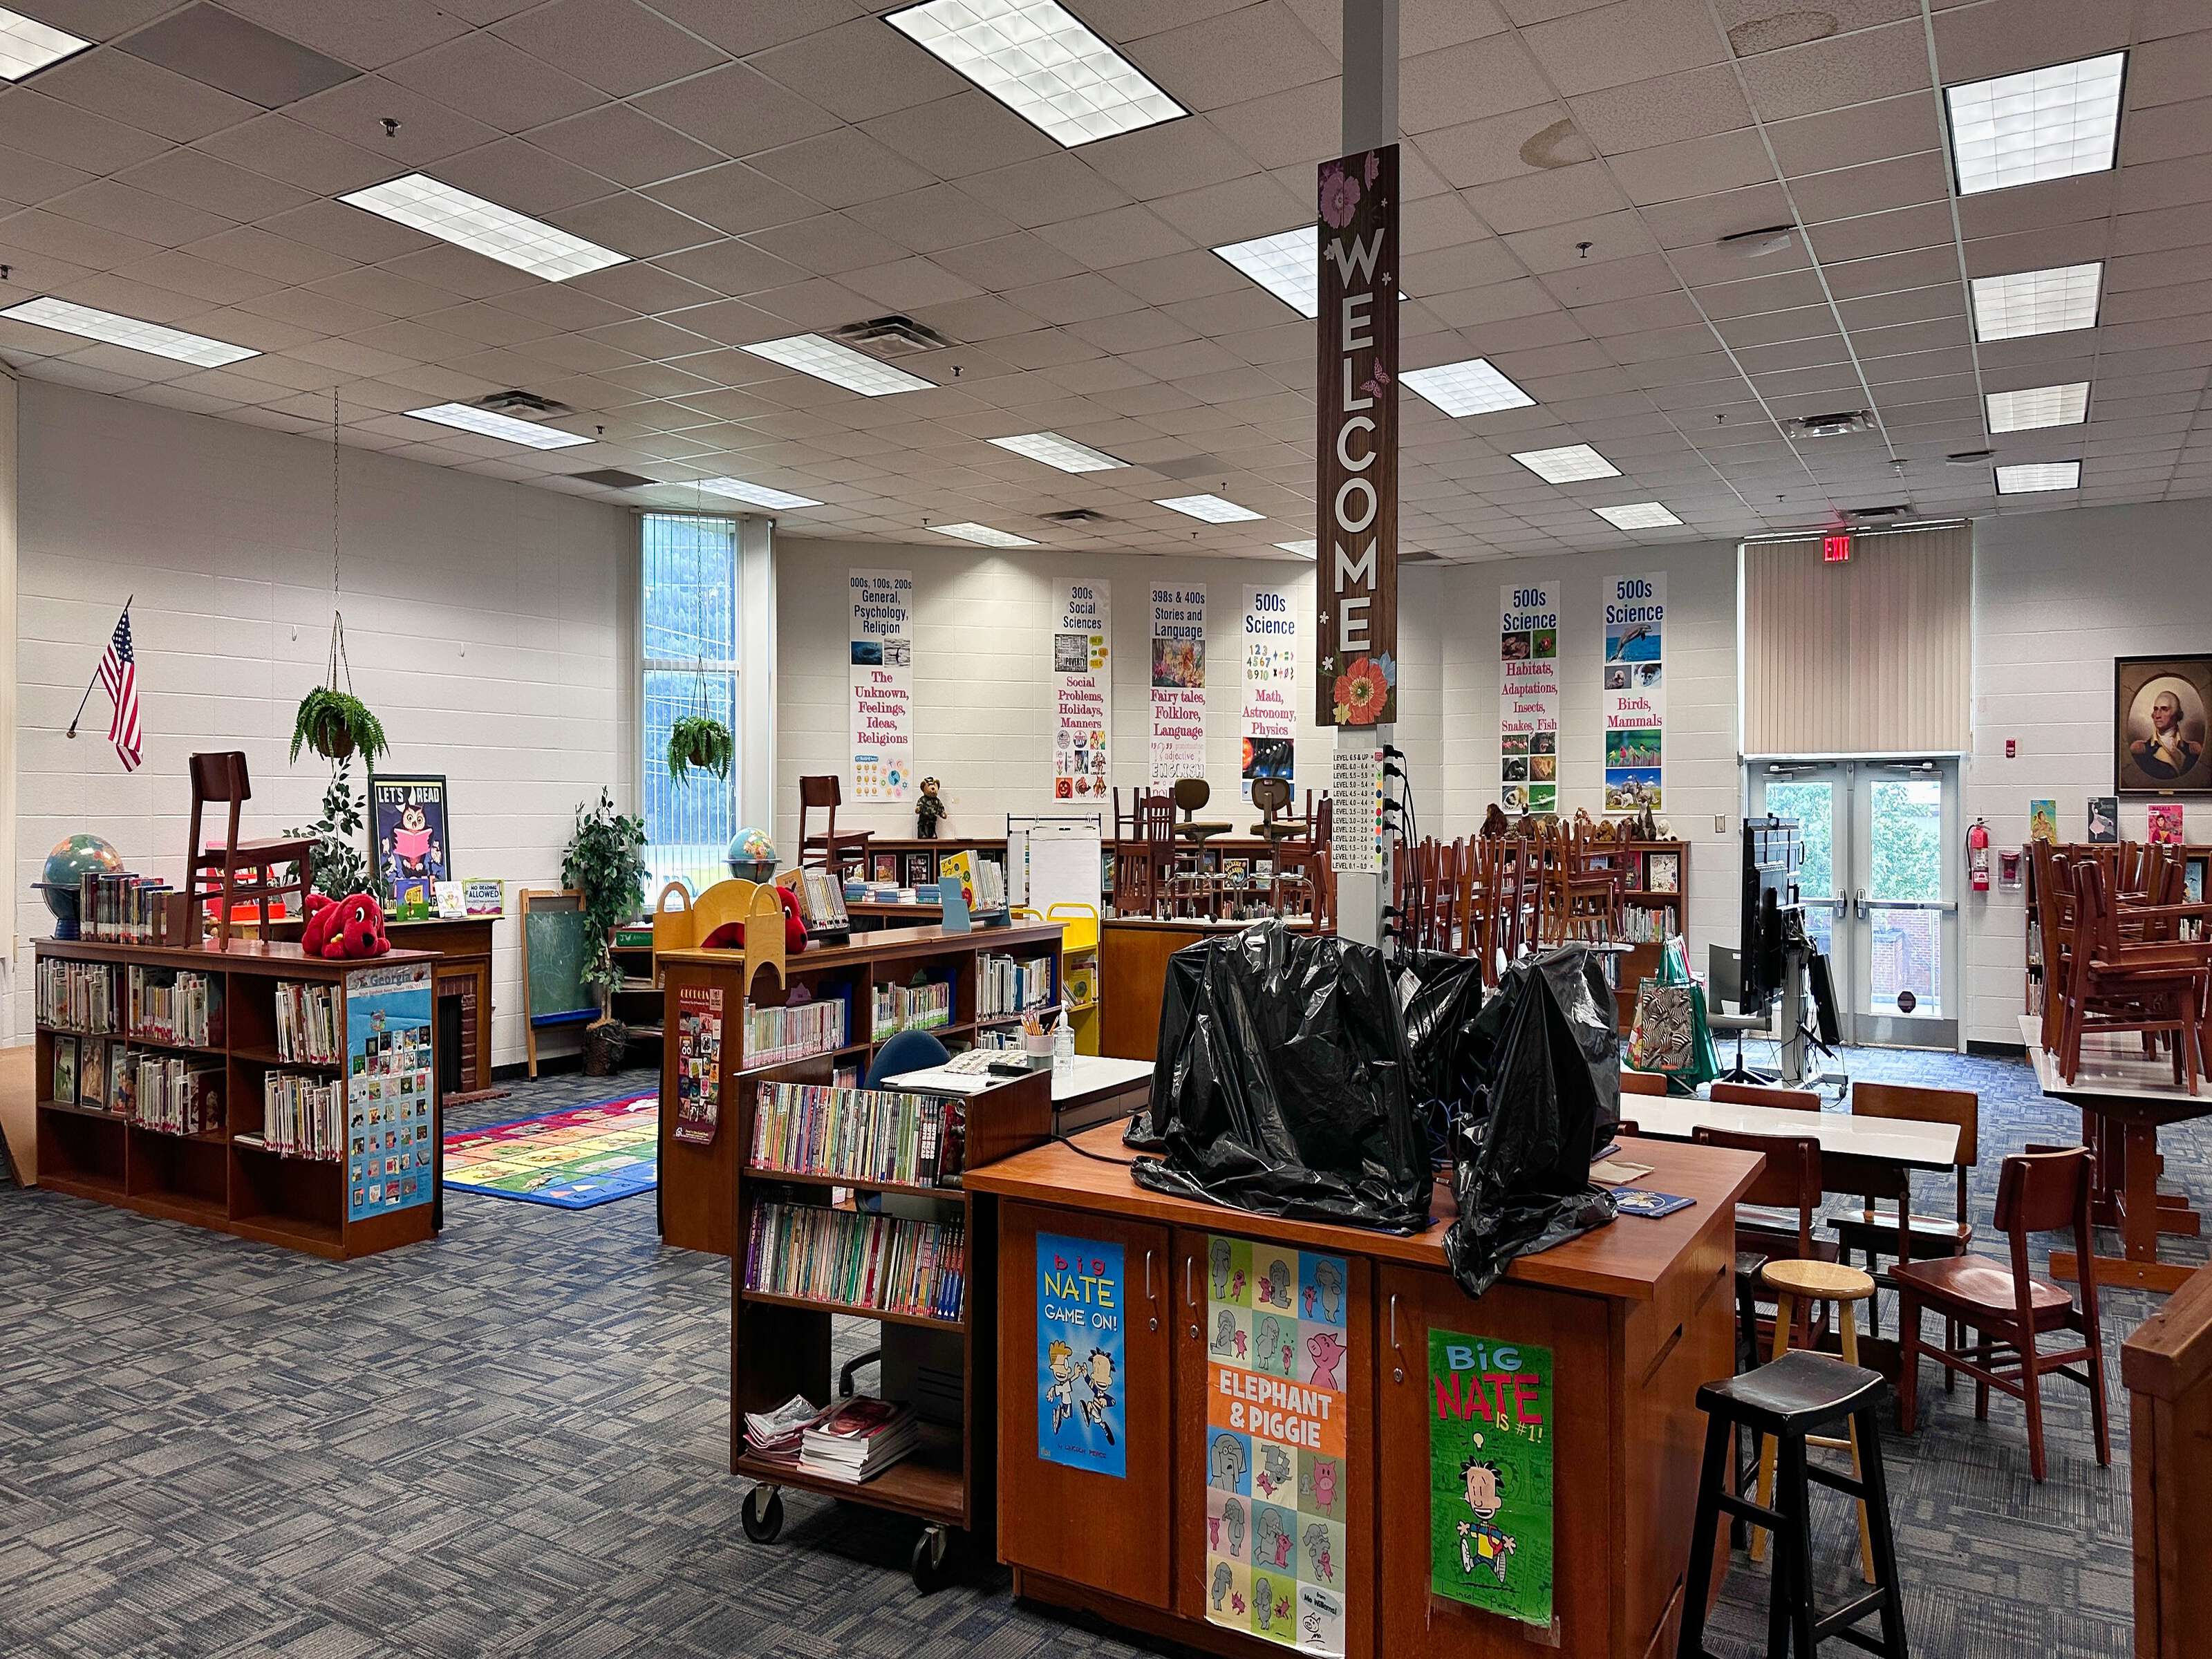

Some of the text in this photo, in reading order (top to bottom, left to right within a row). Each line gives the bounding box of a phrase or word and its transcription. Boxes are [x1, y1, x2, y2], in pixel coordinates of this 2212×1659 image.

[1331, 229, 1385, 652] WELCOME
[1825, 536, 1850, 561] EXIT
[850, 577, 912, 590] 000s, 100s, 200s
[1617, 579, 1652, 600] 500s
[863, 590, 900, 605] General,
[1071, 586, 1093, 599] 300s
[1152, 590, 1205, 604] 398s & 400s
[1513, 589, 1546, 608] 500s
[1069, 601, 1096, 614] Social
[1255, 594, 1286, 612] 500s
[854, 605, 908, 621] Psychology,
[1155, 607, 1202, 621] Stories and
[1606, 603, 1664, 624] Science
[863, 620, 900, 635] Religion
[1063, 616, 1102, 629] Sciences
[1246, 615, 1295, 635] Science
[1503, 612, 1557, 631] Science
[1155, 622, 1202, 640] Language
[1065, 657, 1085, 666] POVERTY
[1506, 661, 1553, 677] Habitats,
[871, 671, 892, 682] The
[1067, 676, 1095, 688] Social
[854, 686, 909, 700] Unknown,
[1058, 690, 1104, 703] Problems,
[1150, 689, 1206, 705] Fairy tales,
[1255, 689, 1284, 705] Math,
[1501, 682, 1558, 697] Adaptations,
[858, 702, 906, 716] Feelings,
[1058, 704, 1103, 718] Holidays,
[1513, 701, 1546, 714] Insects,
[1617, 697, 1651, 712] Birds,
[1155, 706, 1201, 723] Folklore,
[1242, 706, 1296, 722] Astronomy,
[1607, 714, 1662, 729] Mammals
[867, 717, 897, 731] Ideas,
[1061, 718, 1101, 729] Manners
[1154, 723, 1203, 740] Language
[1251, 722, 1288, 738] Physics
[1502, 718, 1557, 734] Snakes, Fish
[857, 731, 908, 747] Religions
[1165, 751, 1194, 762] adjective
[1152, 763, 1204, 778] ENGLISH
[378, 787, 440, 803] LET'S READ
[370, 973, 411, 986] Georgia
[680, 988, 709, 1000] GEORGIA
[1054, 1252, 1105, 1275] big
[1044, 1271, 1114, 1308] NATE
[1044, 1304, 1118, 1331] GAME ON!
[1220, 1369, 1331, 1420] ELEPHANT
[1434, 1371, 1542, 1424] NATE
[1230, 1402, 1321, 1448] & PIGGIE
[1496, 1412, 1543, 1443] IS #1!
[1304, 1593, 1313, 1603] Mo
